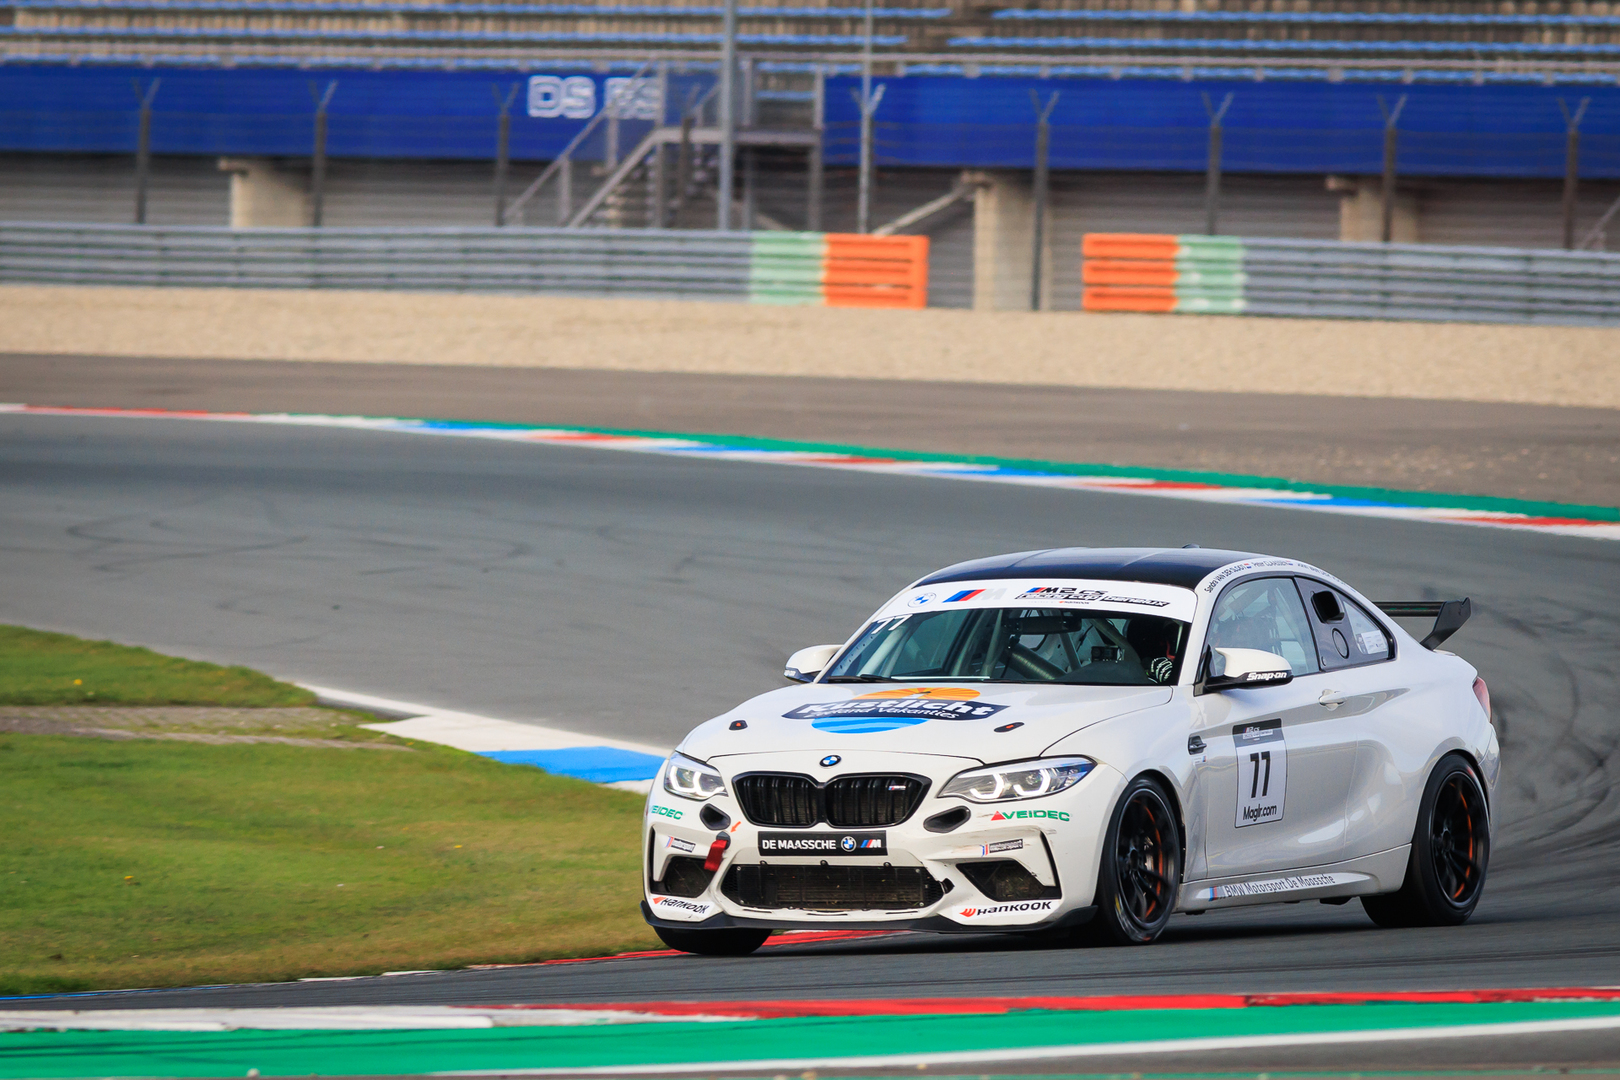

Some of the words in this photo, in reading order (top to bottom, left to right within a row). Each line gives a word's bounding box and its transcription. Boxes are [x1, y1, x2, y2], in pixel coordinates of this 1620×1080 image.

[1247, 672, 1287, 681] Snap-on
[797, 699, 994, 716] Kustlicht
[651, 805, 684, 820] EIDEC
[1002, 810, 1070, 821] VEIDEC
[762, 839, 776, 849] DE
[778, 839, 836, 849] MAASSCHE
[1224, 884, 1246, 897] BMW
[1245, 878, 1287, 894] Motorsport
[1285, 877, 1299, 889] De
